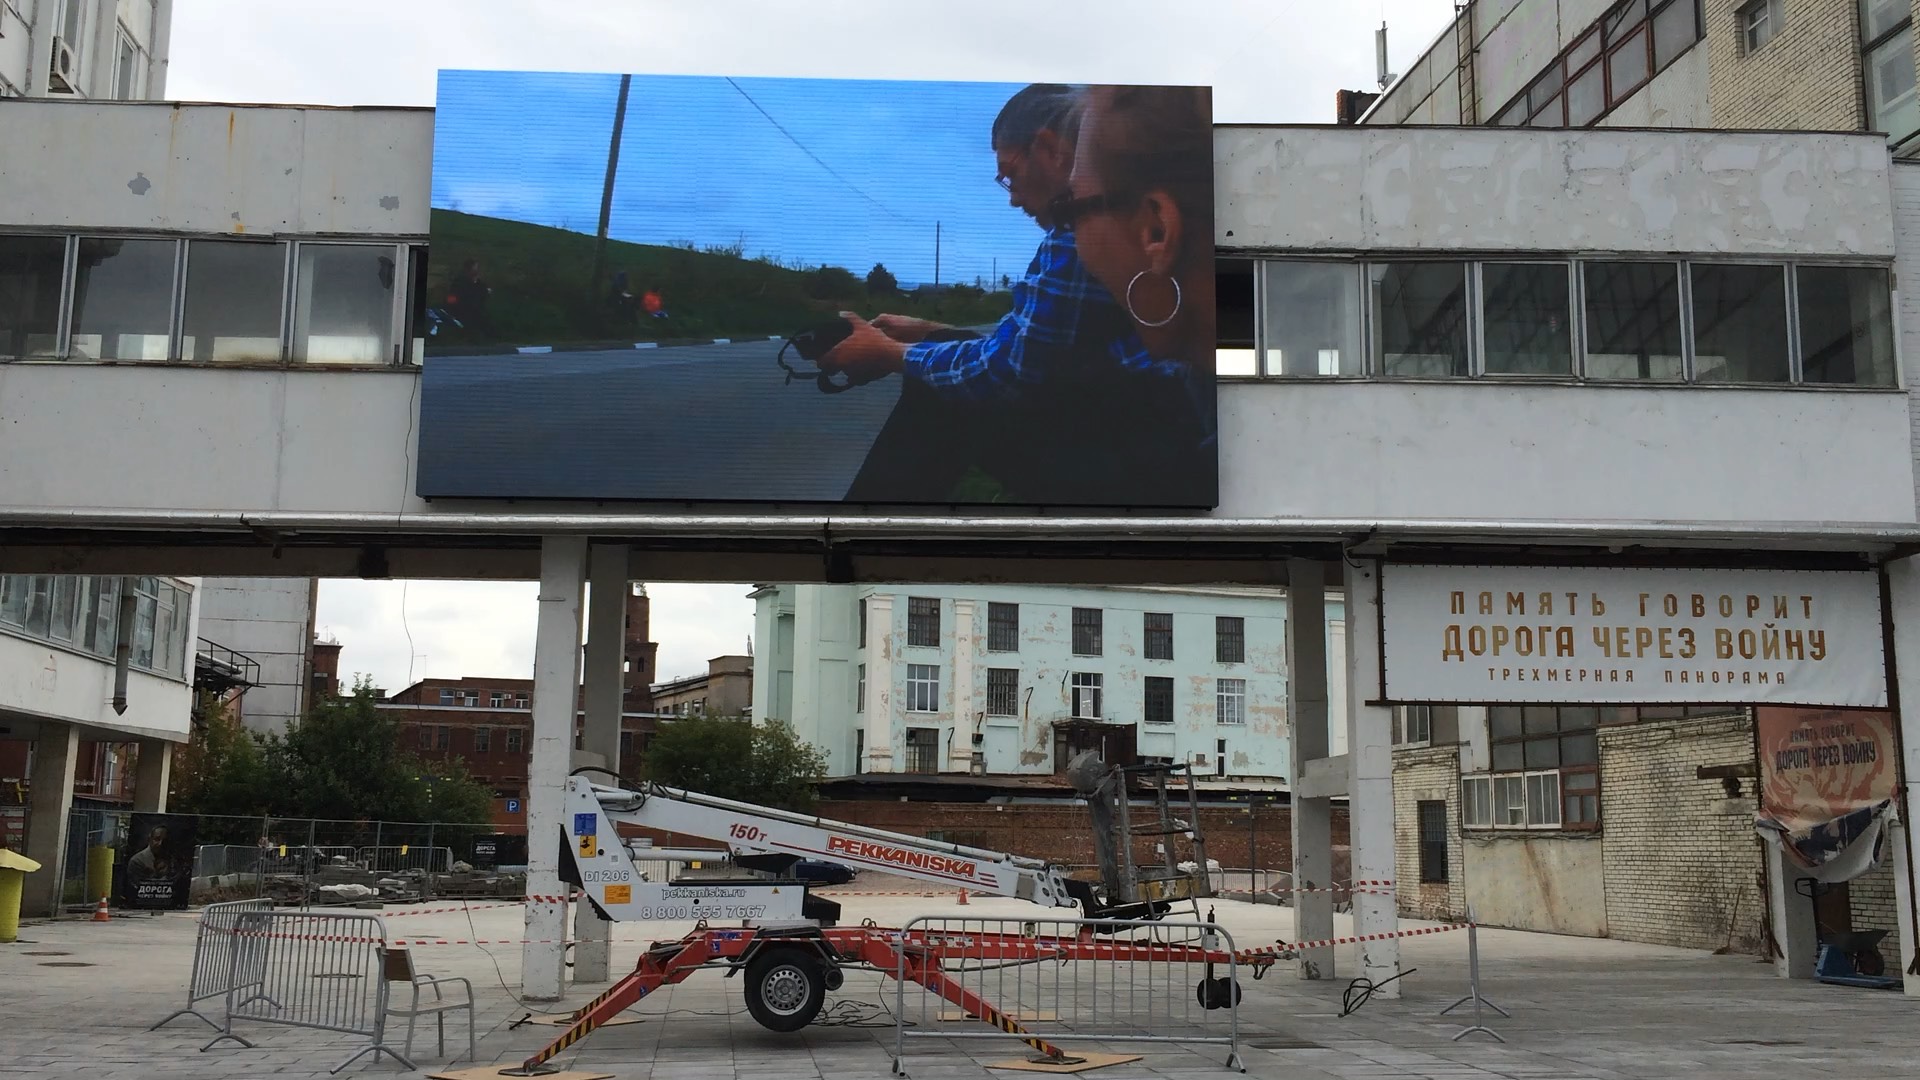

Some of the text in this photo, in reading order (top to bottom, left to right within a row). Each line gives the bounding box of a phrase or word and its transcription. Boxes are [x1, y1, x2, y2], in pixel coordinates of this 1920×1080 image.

[1450, 591, 1814, 619] ПАМЯТЬ ГОВОРИТ
[1442, 623, 1827, 662] ДОРОГА ЧЕРЕЗ ВОЙНУ
[1488, 668, 1786, 685] ТРЕХМЕРНАЯ ПАНОРАМА
[1776, 738, 1876, 774] ДОРОГА ЧЕРЕЗ ВОЙНУ
[827, 835, 977, 879] PEKKANISKA
[602, 870, 630, 882] 206
[662, 887, 746, 900] pekkaniska.ru
[641, 905, 766, 919] 8 800 555 7667
